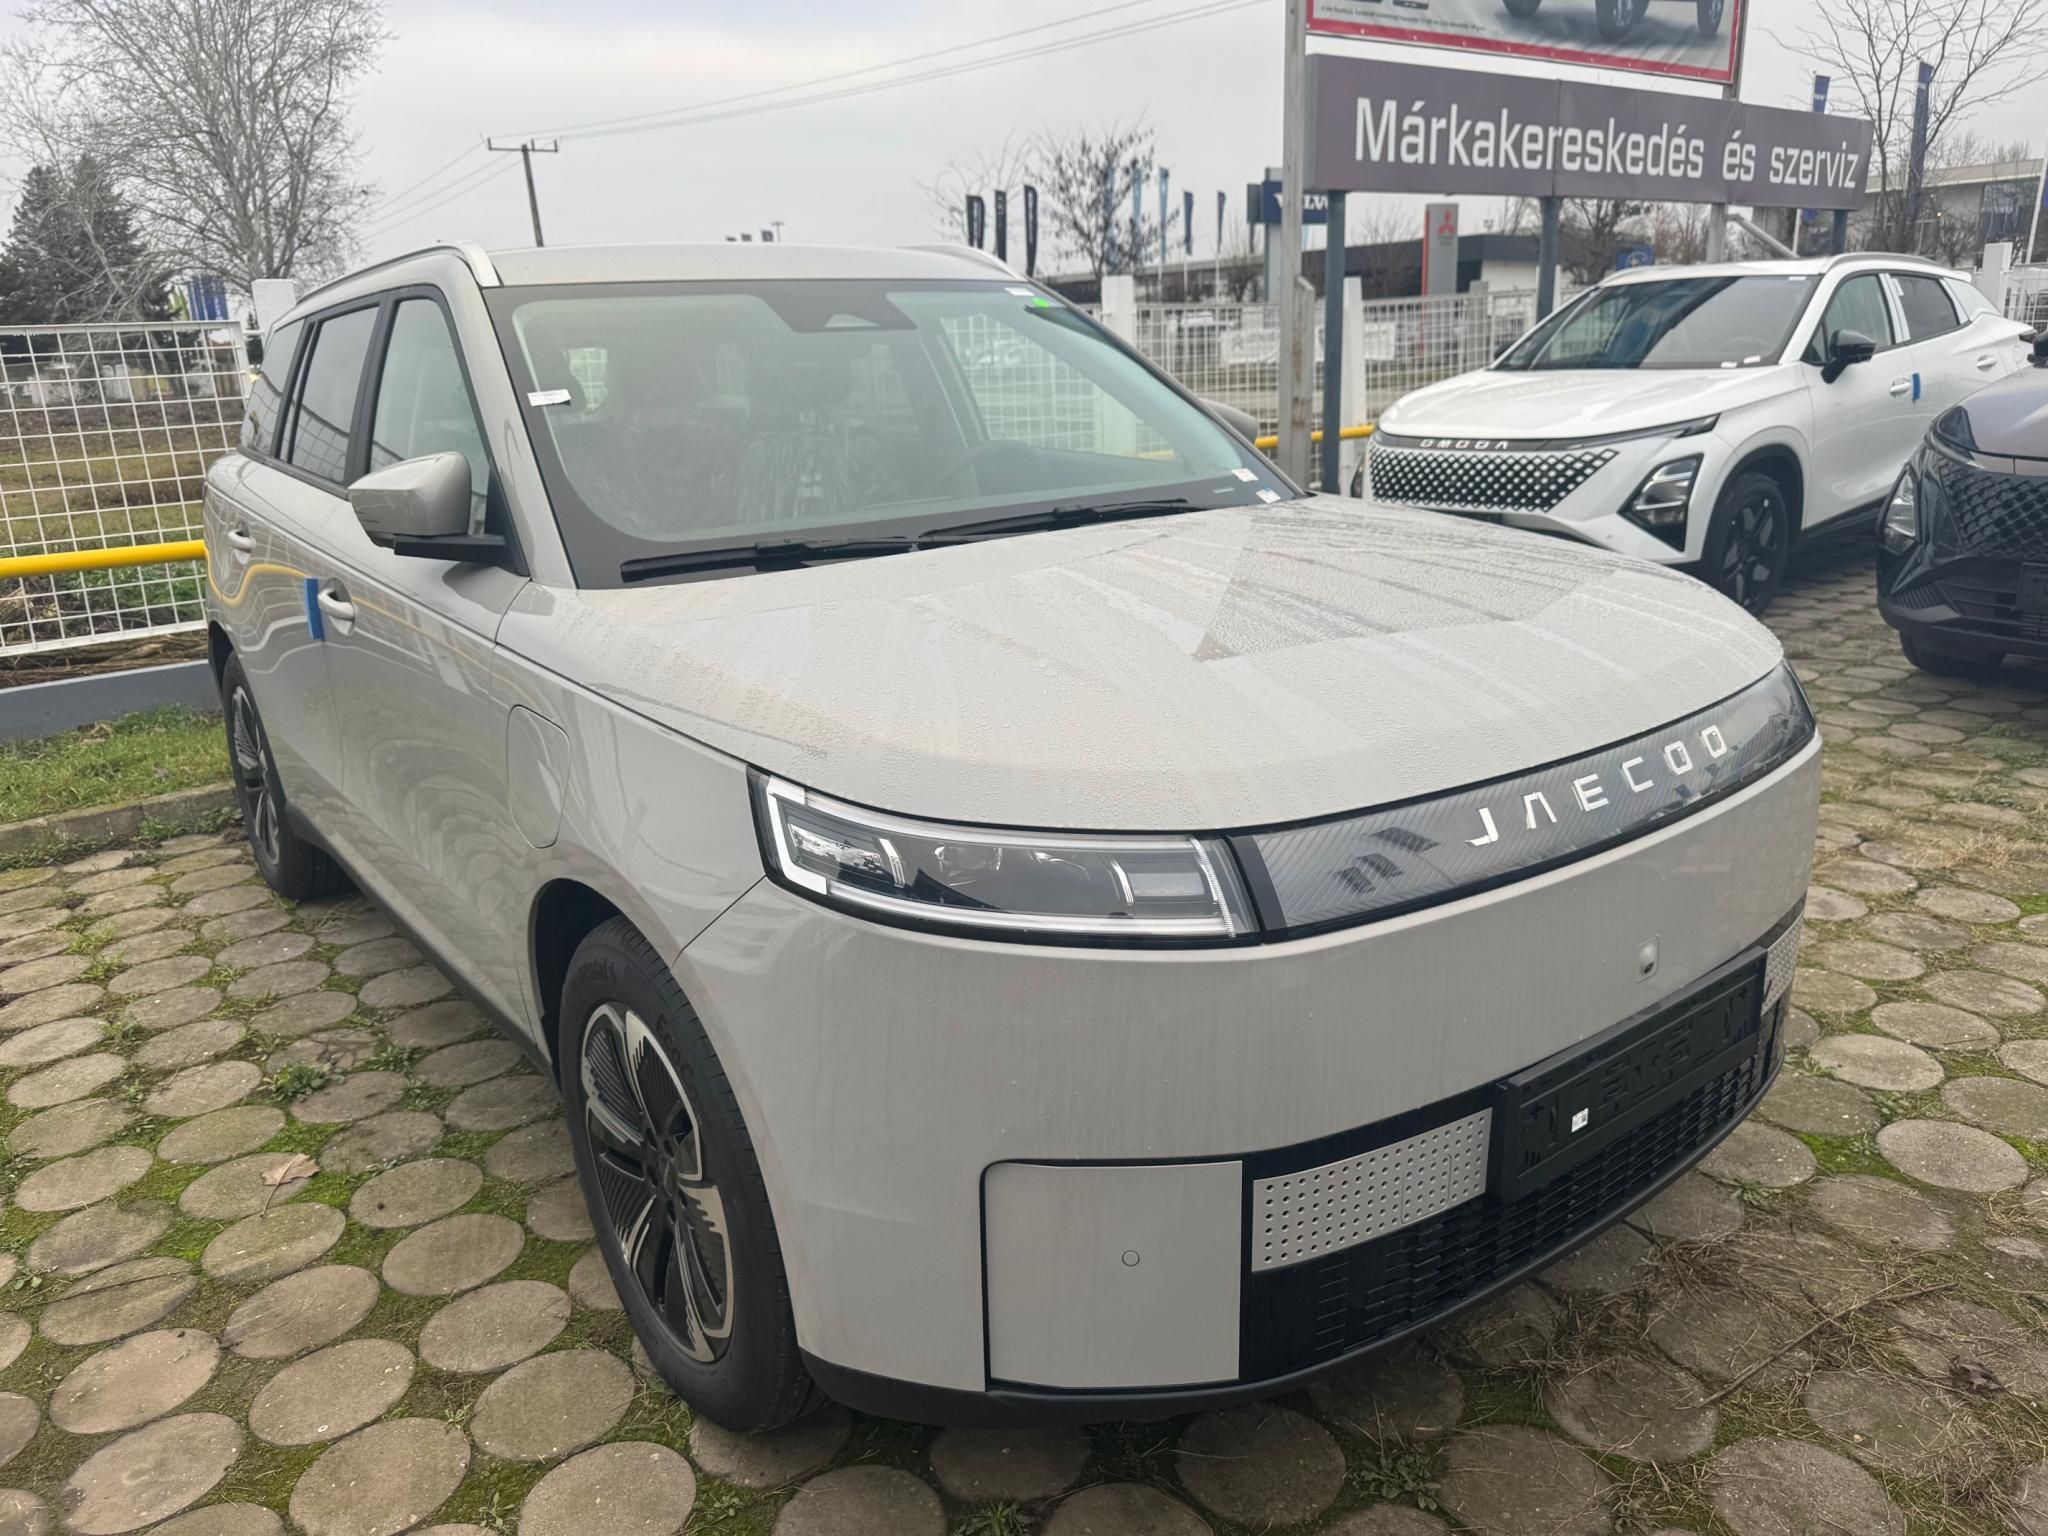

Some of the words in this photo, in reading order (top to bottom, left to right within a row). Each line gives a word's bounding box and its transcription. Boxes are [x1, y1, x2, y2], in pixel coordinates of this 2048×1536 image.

[1355, 97, 1705, 180] Márkakereskedés
[1722, 130, 1756, 183] és
[1769, 141, 1860, 189] szerviz
[1272, 192, 1328, 210] VLV
[1419, 438, 1509, 450] OMODA
[1464, 724, 1728, 847] JAECOO
